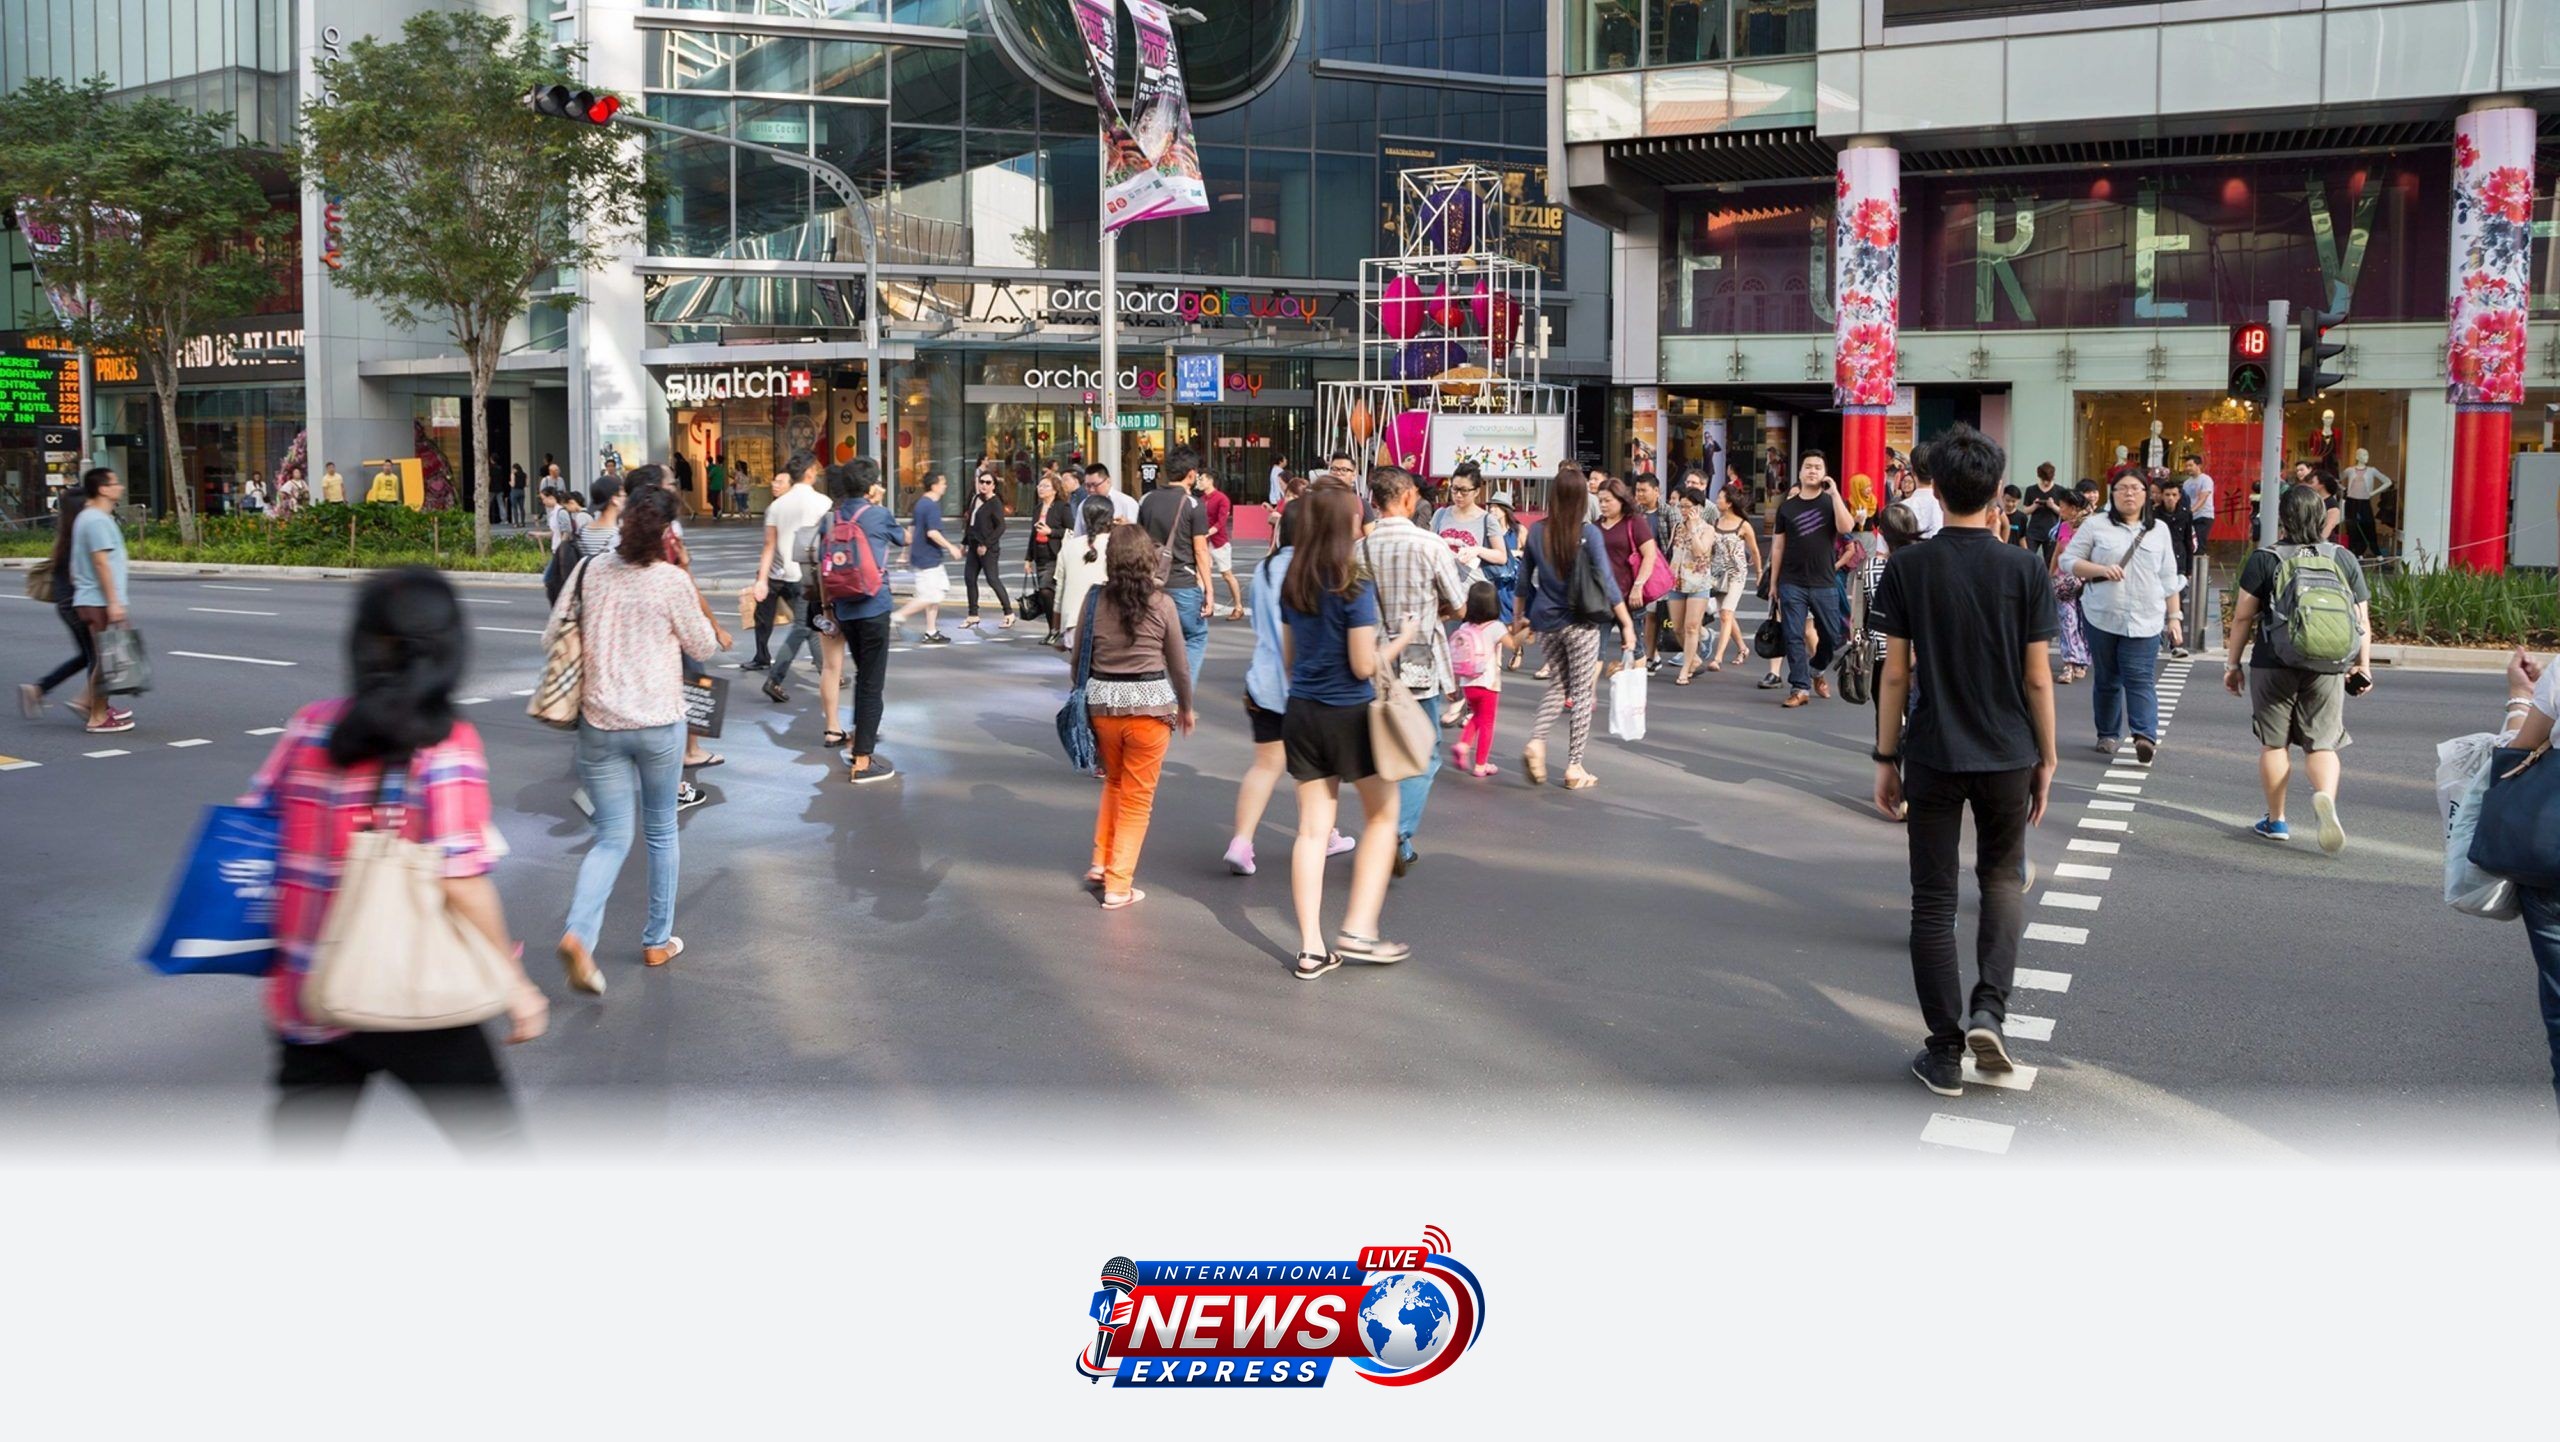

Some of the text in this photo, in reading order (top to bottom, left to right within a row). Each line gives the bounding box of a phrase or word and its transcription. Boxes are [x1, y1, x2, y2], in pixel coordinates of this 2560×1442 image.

[1509, 197, 1563, 229] izzue
[2245, 329, 2265, 354] 18
[95, 356, 139, 382] PRICES
[59, 382, 79, 392] 177
[665, 366, 789, 402] swatch
[12, 391, 47, 401] POINT
[19, 402, 55, 413] HOTEL
[59, 404, 80, 414] 222
[14, 413, 35, 424] INN
[60, 415, 80, 425] 144
[1143, 414, 1157, 427] RD
